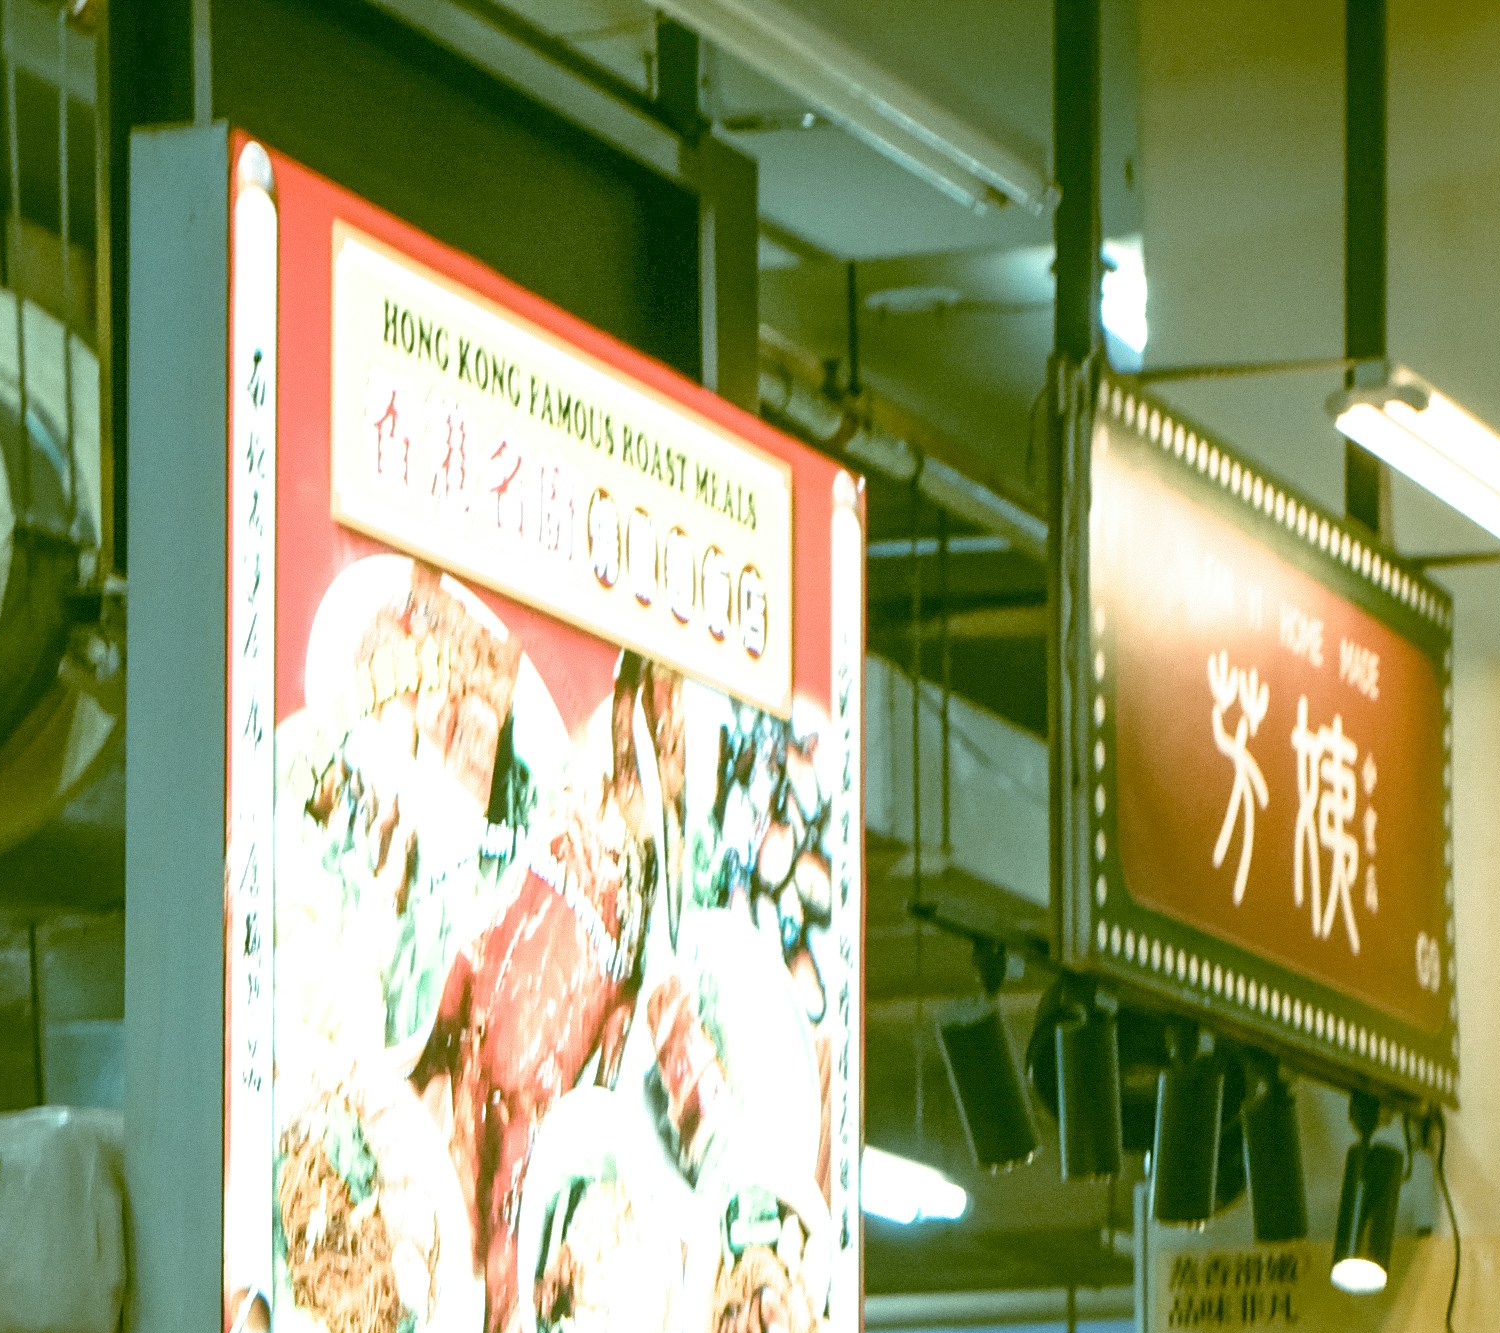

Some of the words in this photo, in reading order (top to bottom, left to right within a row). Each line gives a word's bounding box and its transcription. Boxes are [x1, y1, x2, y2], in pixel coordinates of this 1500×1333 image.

[382, 296, 449, 372] HONG
[456, 334, 522, 409] KONG
[528, 373, 614, 457] FAMOUS
[622, 422, 687, 494] ROAST
